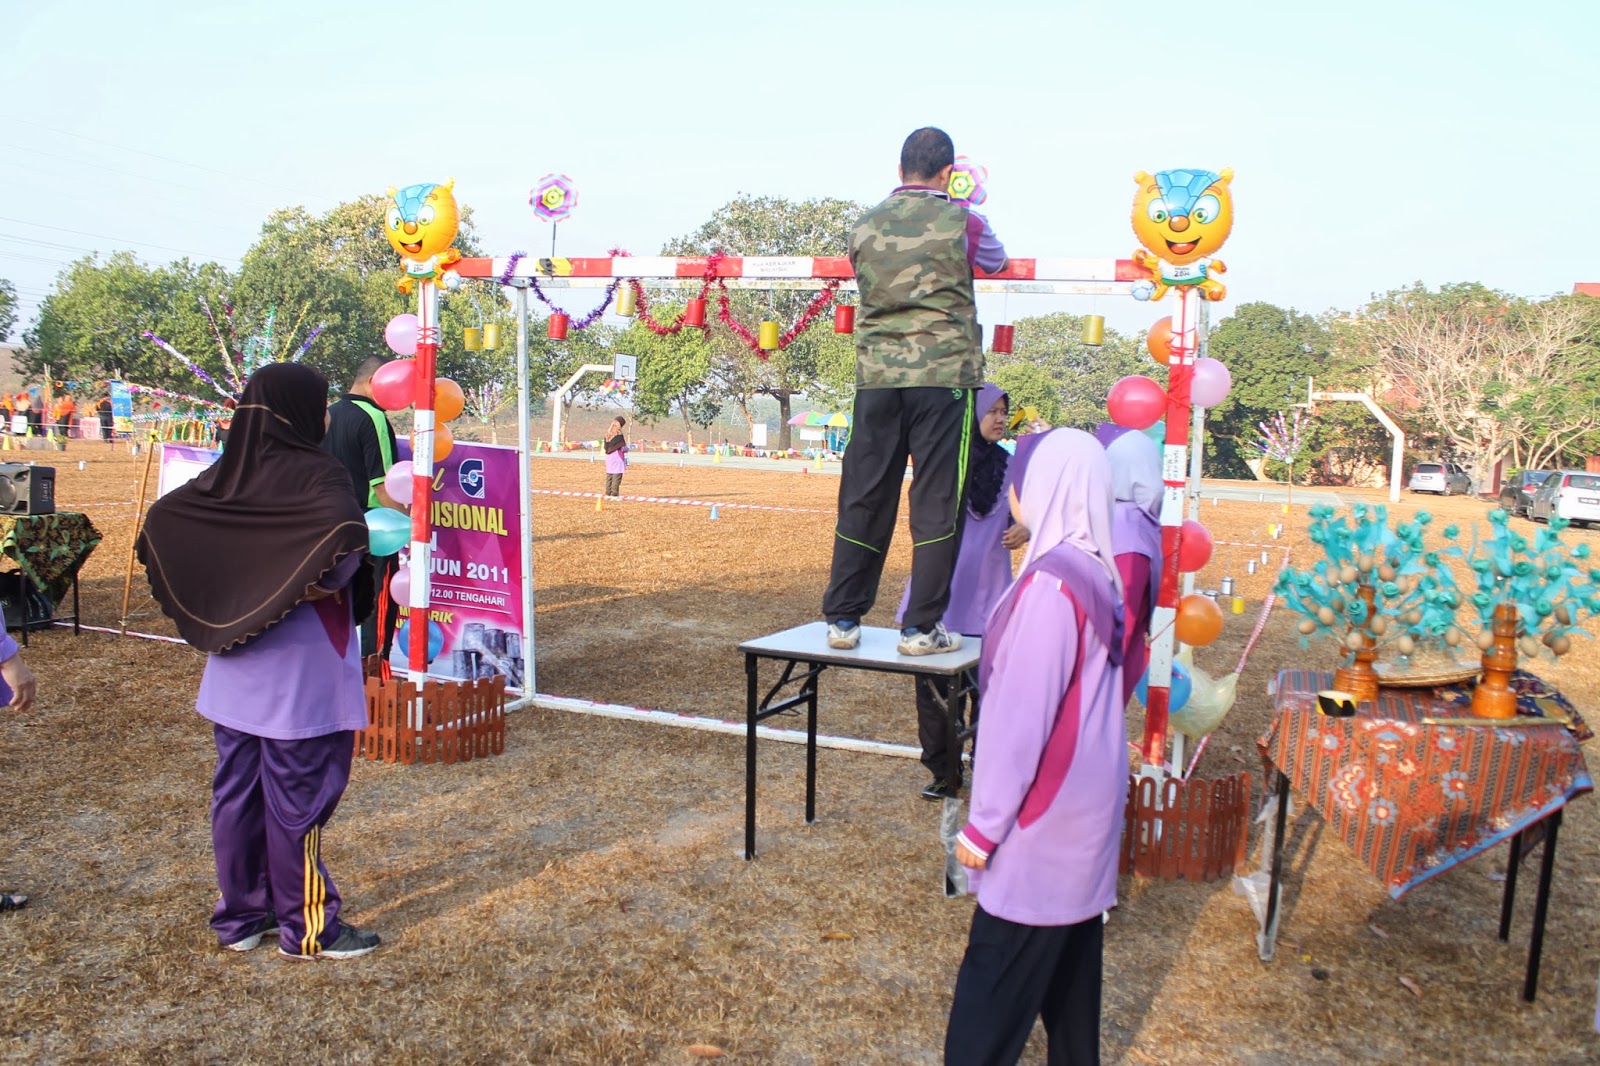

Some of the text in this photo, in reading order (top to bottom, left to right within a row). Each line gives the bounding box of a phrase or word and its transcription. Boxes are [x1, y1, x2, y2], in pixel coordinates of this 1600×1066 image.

[430, 557, 461, 577] JUN
[466, 562, 508, 584] 2011
[455, 591, 505, 606] TENGAHARI
